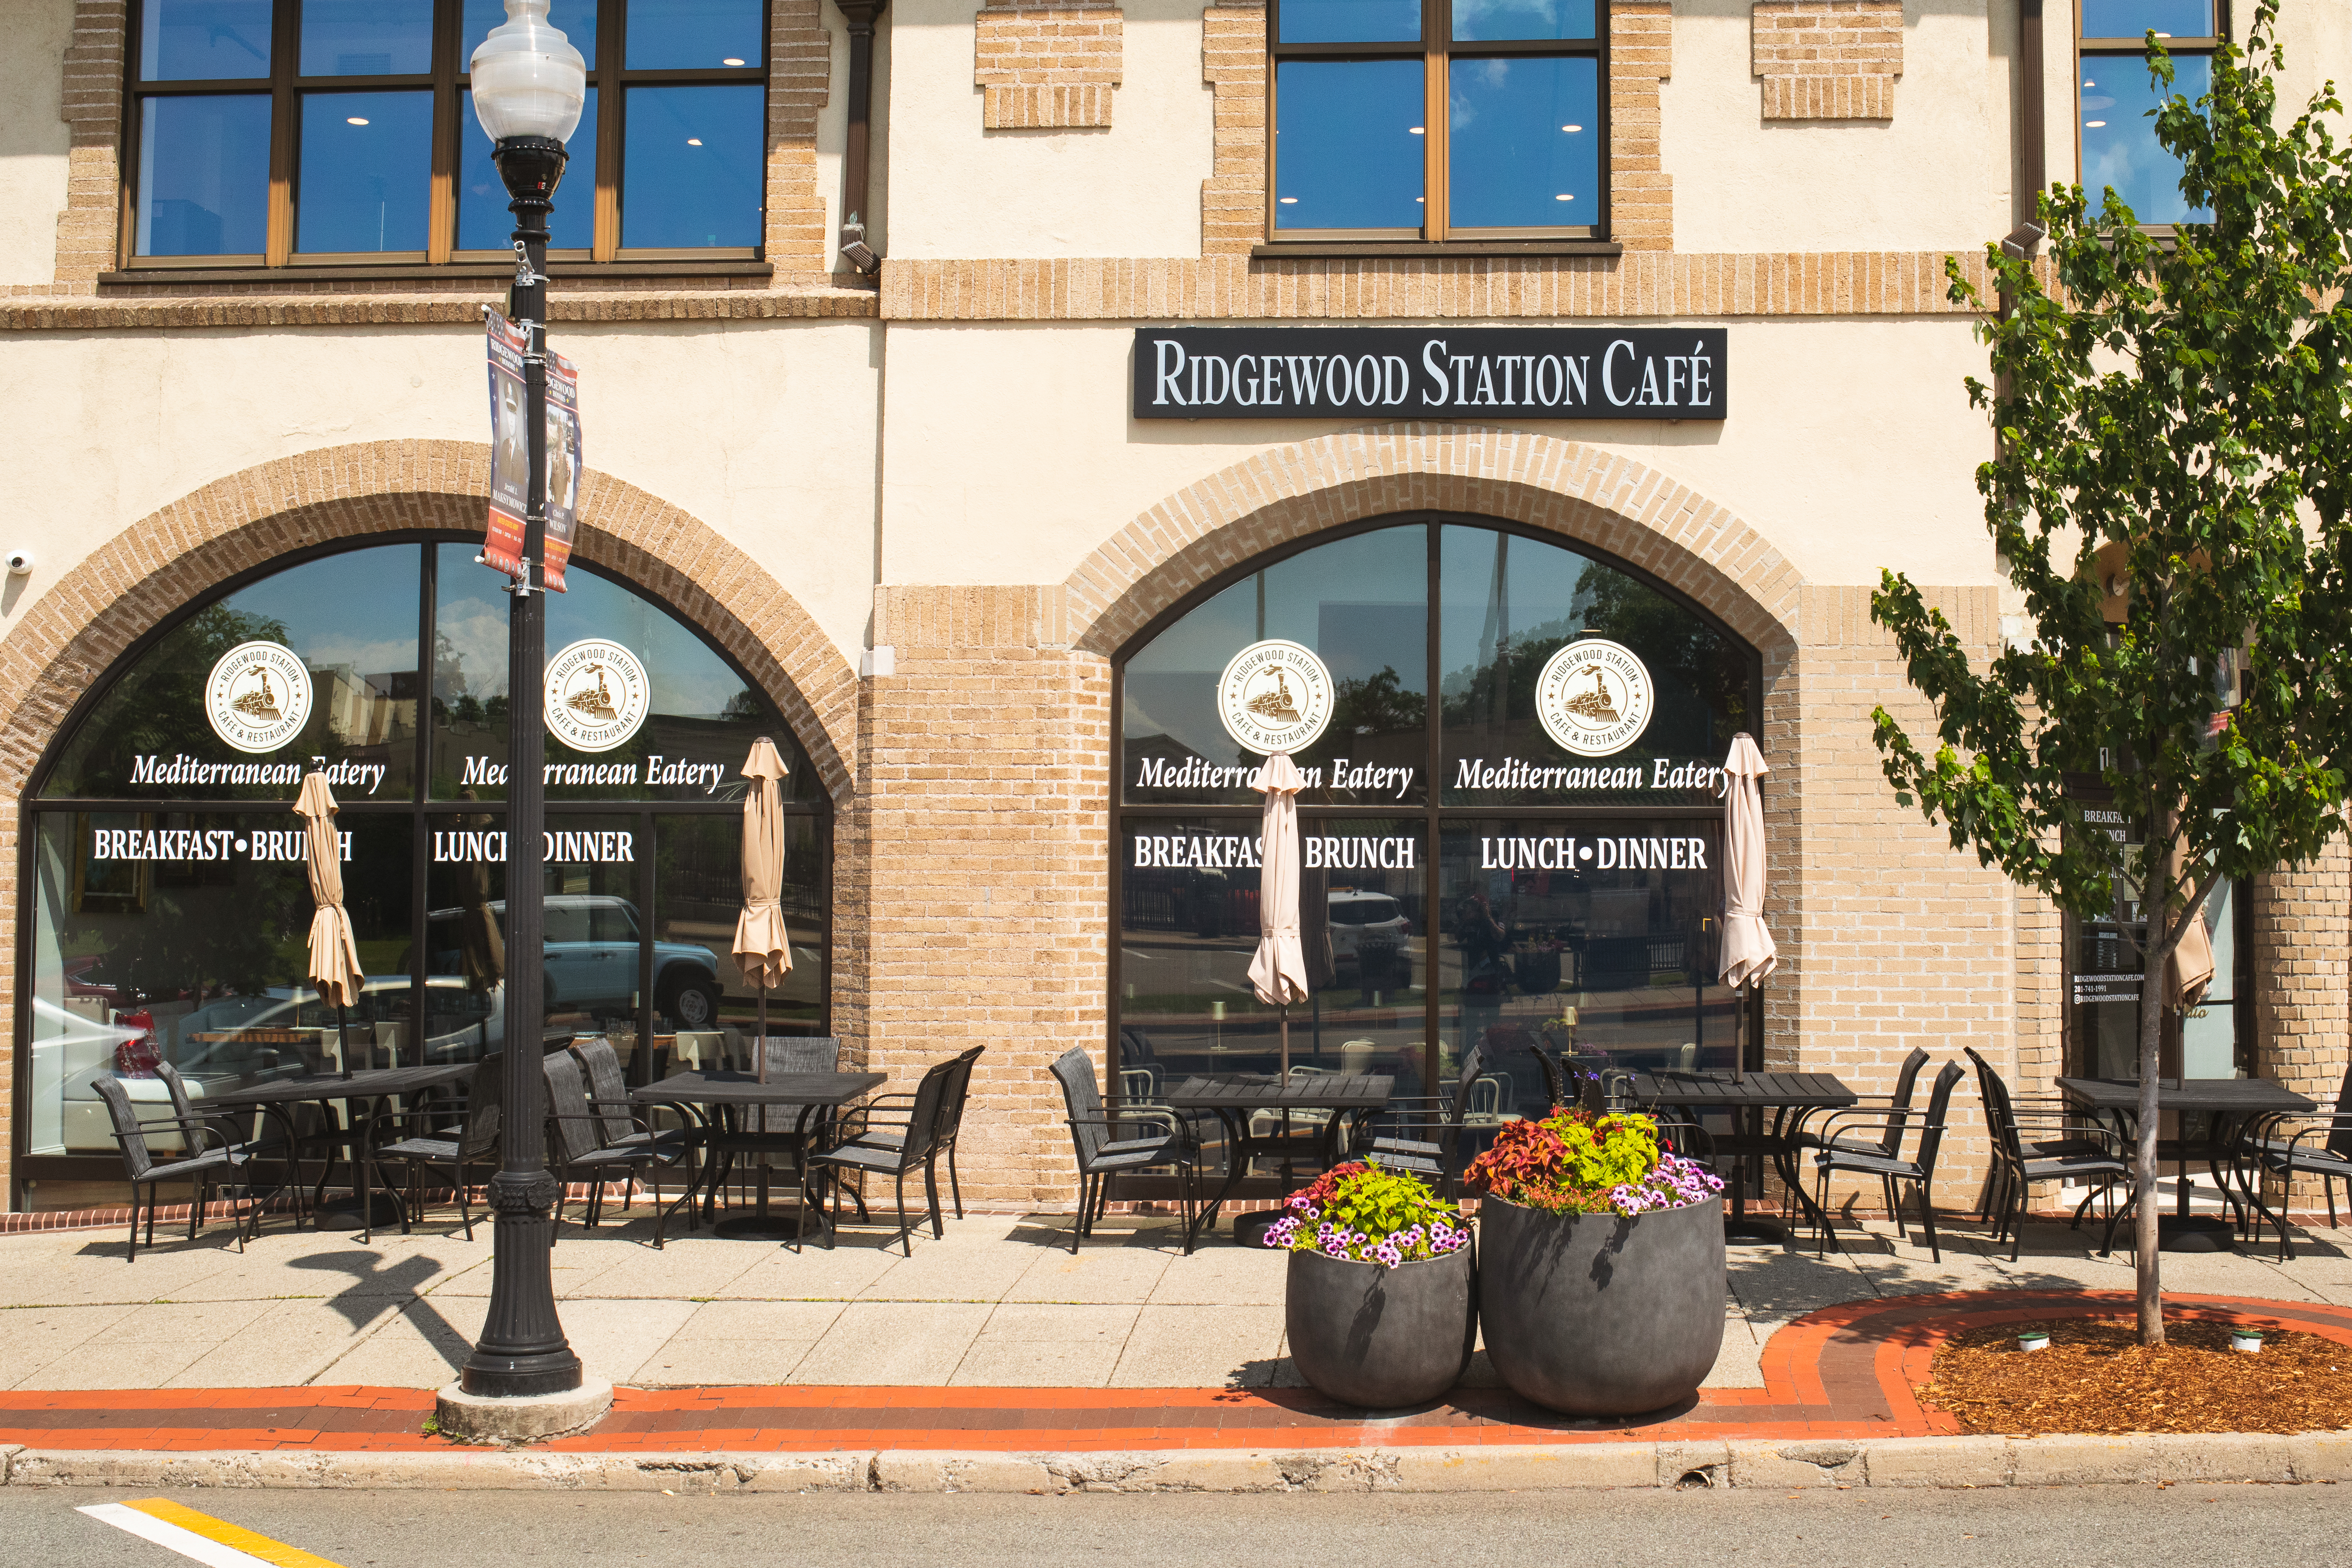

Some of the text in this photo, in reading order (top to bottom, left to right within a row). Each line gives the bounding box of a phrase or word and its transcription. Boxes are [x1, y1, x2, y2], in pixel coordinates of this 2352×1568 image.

[491, 338, 523, 368] RIDGEWOOD
[501, 357, 516, 371] HONORS
[546, 375, 575, 398] IDGEWOOD
[1152, 340, 1712, 406] RIDGEWOOD STATION CAFÉ
[553, 390, 566, 402] HONORS
[493, 489, 527, 513] MAKSYMOWICZ
[549, 519, 567, 533] WILSON
[220, 651, 300, 682] RIDGEWOOD STATION
[556, 649, 637, 682] RIDGEWOOD STATION
[1234, 650, 1319, 682] RIDGEWOOD STATION
[1551, 650, 1639, 682] RIDGEWOOD STATION
[218, 711, 300, 742] CAFÉ & RESTAURANT
[552, 708, 636, 741] CAFÉ & RESTAURANT
[1232, 712, 1321, 745] CAFÉ & RESTAURANT
[1550, 712, 1640, 745] CAFÉ & RESTAURANT
[130, 753, 301, 785] Mediterranean
[645, 756, 724, 794] Eatery
[1330, 759, 1413, 799] Eatery
[1454, 757, 1729, 798] Mediterranean Eatery
[94, 830, 352, 861] BREAKFAST BRUH
[1134, 836, 1415, 868] BREAKFAS BRUNCH
[1481, 838, 1708, 869] LUNCH DINNER
[2075, 974, 2144, 982] RIDGEWOODSTATIONCAFE.COM
[2080, 994, 2139, 1002] RIDGEWOODSTATIONCAFE
